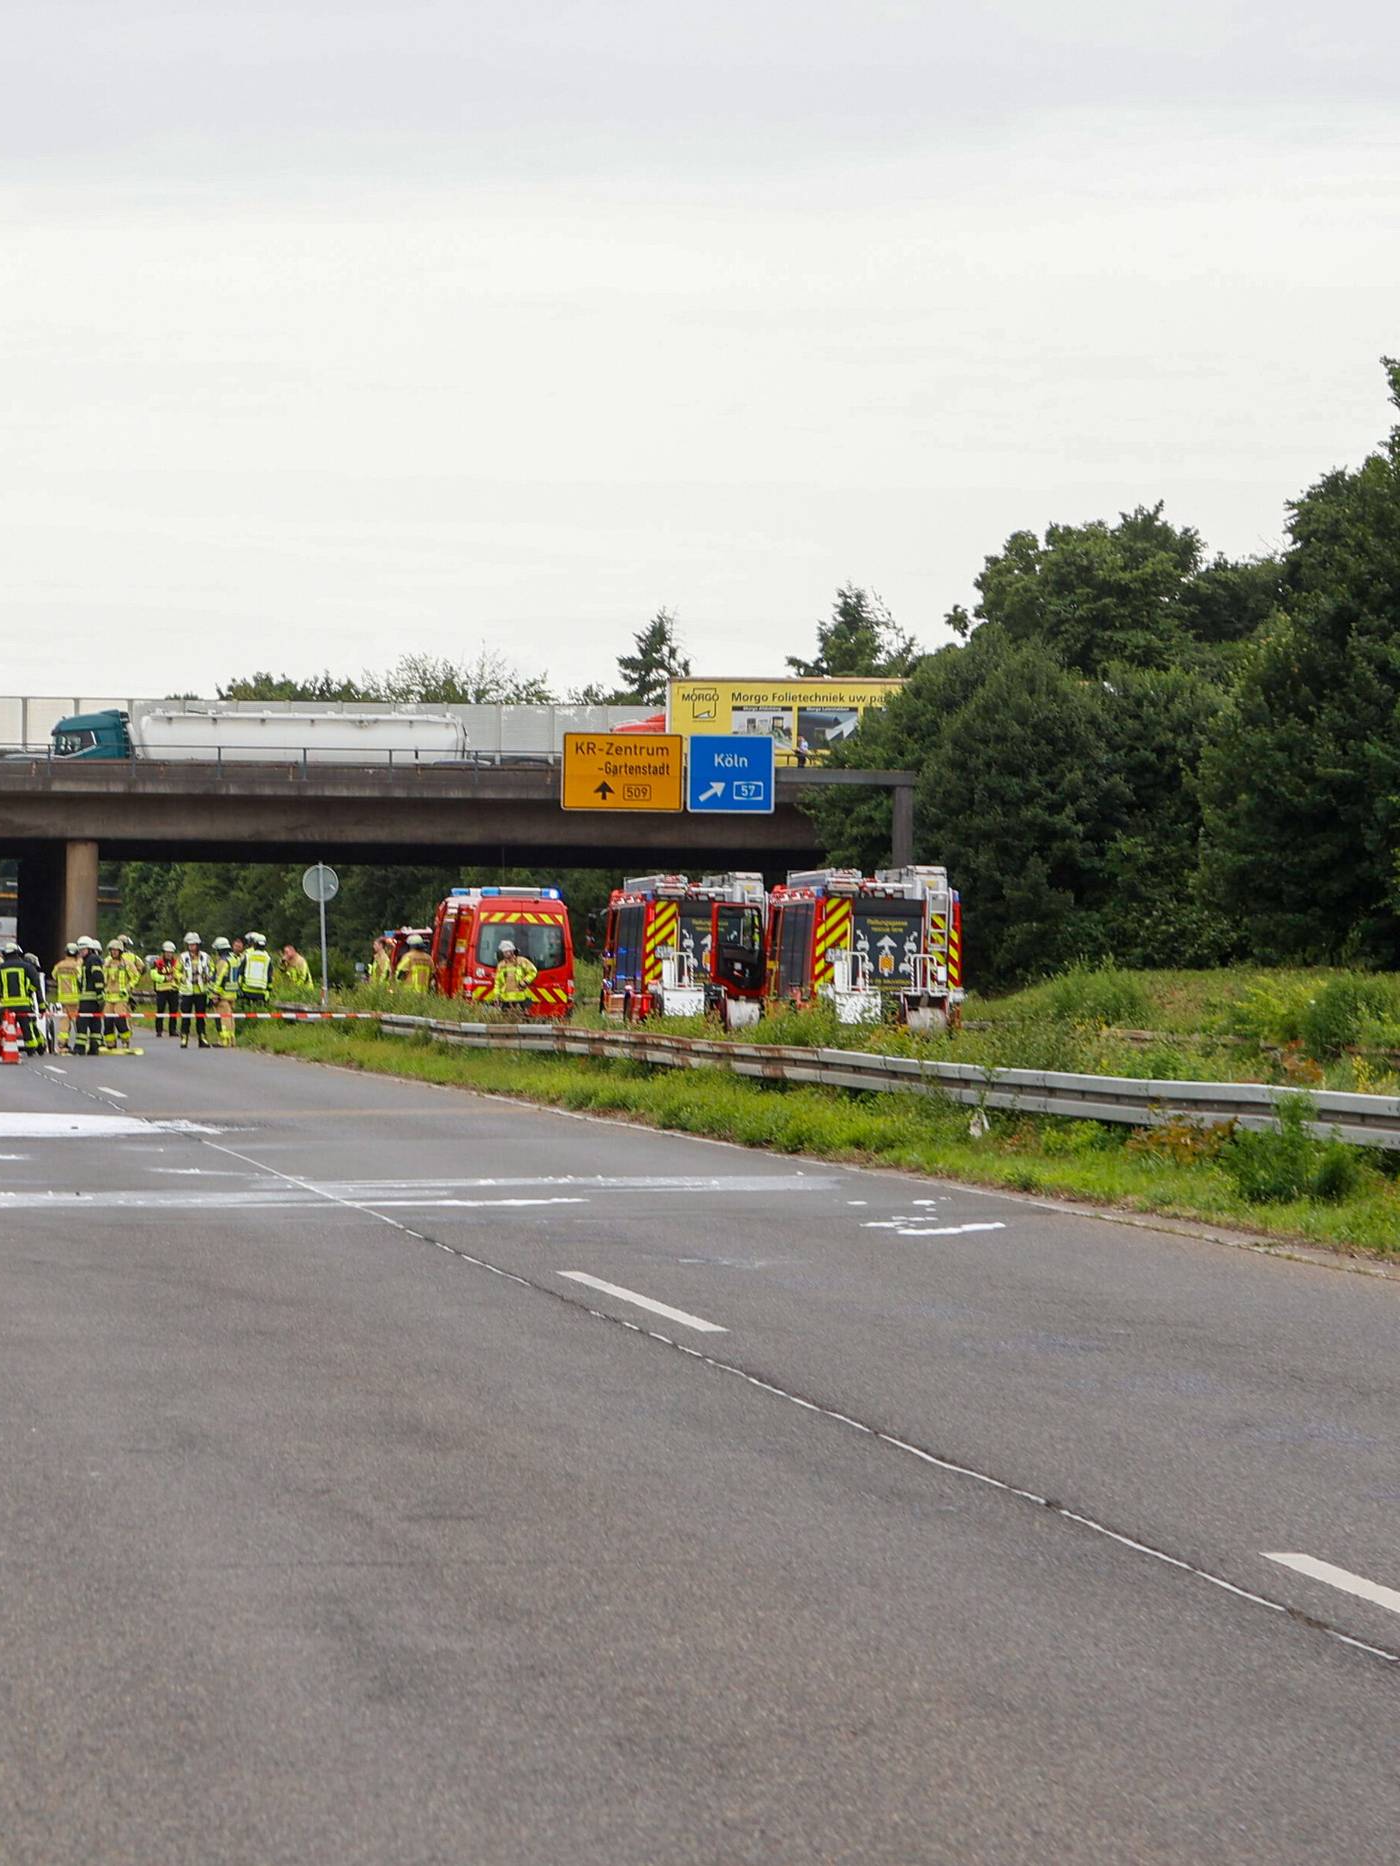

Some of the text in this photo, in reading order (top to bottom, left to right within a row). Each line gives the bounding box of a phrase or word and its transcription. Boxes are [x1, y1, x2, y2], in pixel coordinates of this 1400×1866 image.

[681, 693, 720, 702] MORGO
[731, 692, 769, 704] Morgo
[772, 691, 846, 703] Folietechniek
[848, 694, 866, 703] uw
[575, 741, 670, 757] KR-Zentrum
[713, 752, 749, 768] Köln
[626, 786, 648, 798] 509
[740, 784, 756, 797] 57
